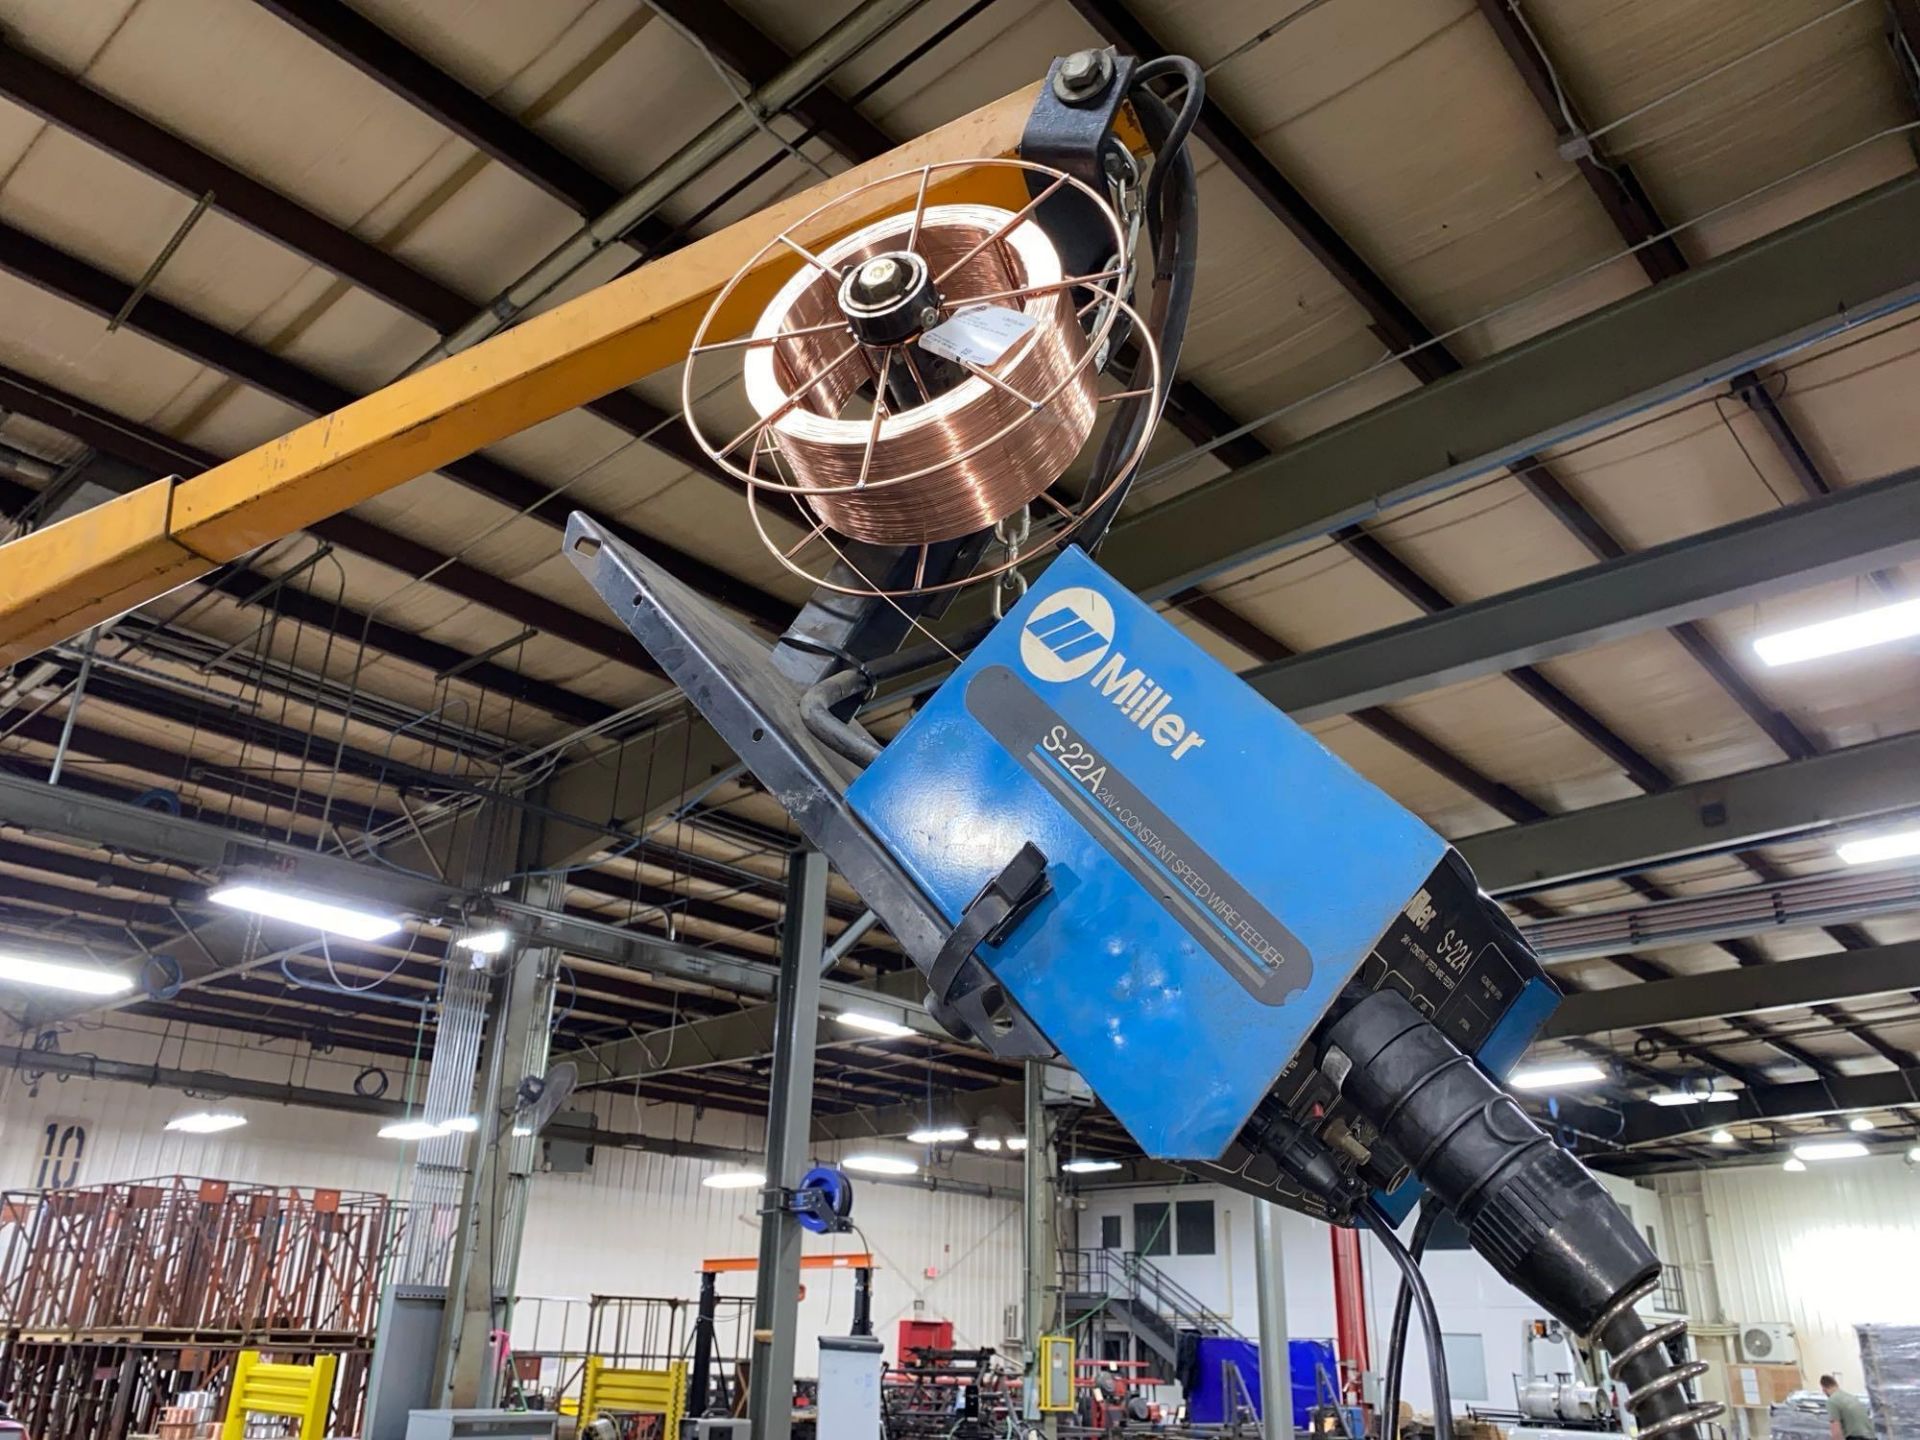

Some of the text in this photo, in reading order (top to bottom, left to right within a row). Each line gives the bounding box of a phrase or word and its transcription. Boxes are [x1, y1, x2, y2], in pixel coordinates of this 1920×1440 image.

[1090, 652, 1206, 760] Miller
[1043, 725, 1106, 793] S-22A
[1120, 808, 1177, 864] CONSTANT
[1172, 859, 1211, 898] SPEED
[1206, 891, 1240, 927] WIRE
[1234, 920, 1285, 969] FEEDER
[1437, 930, 1473, 975] S-22A
[38, 1123, 86, 1189] 10
